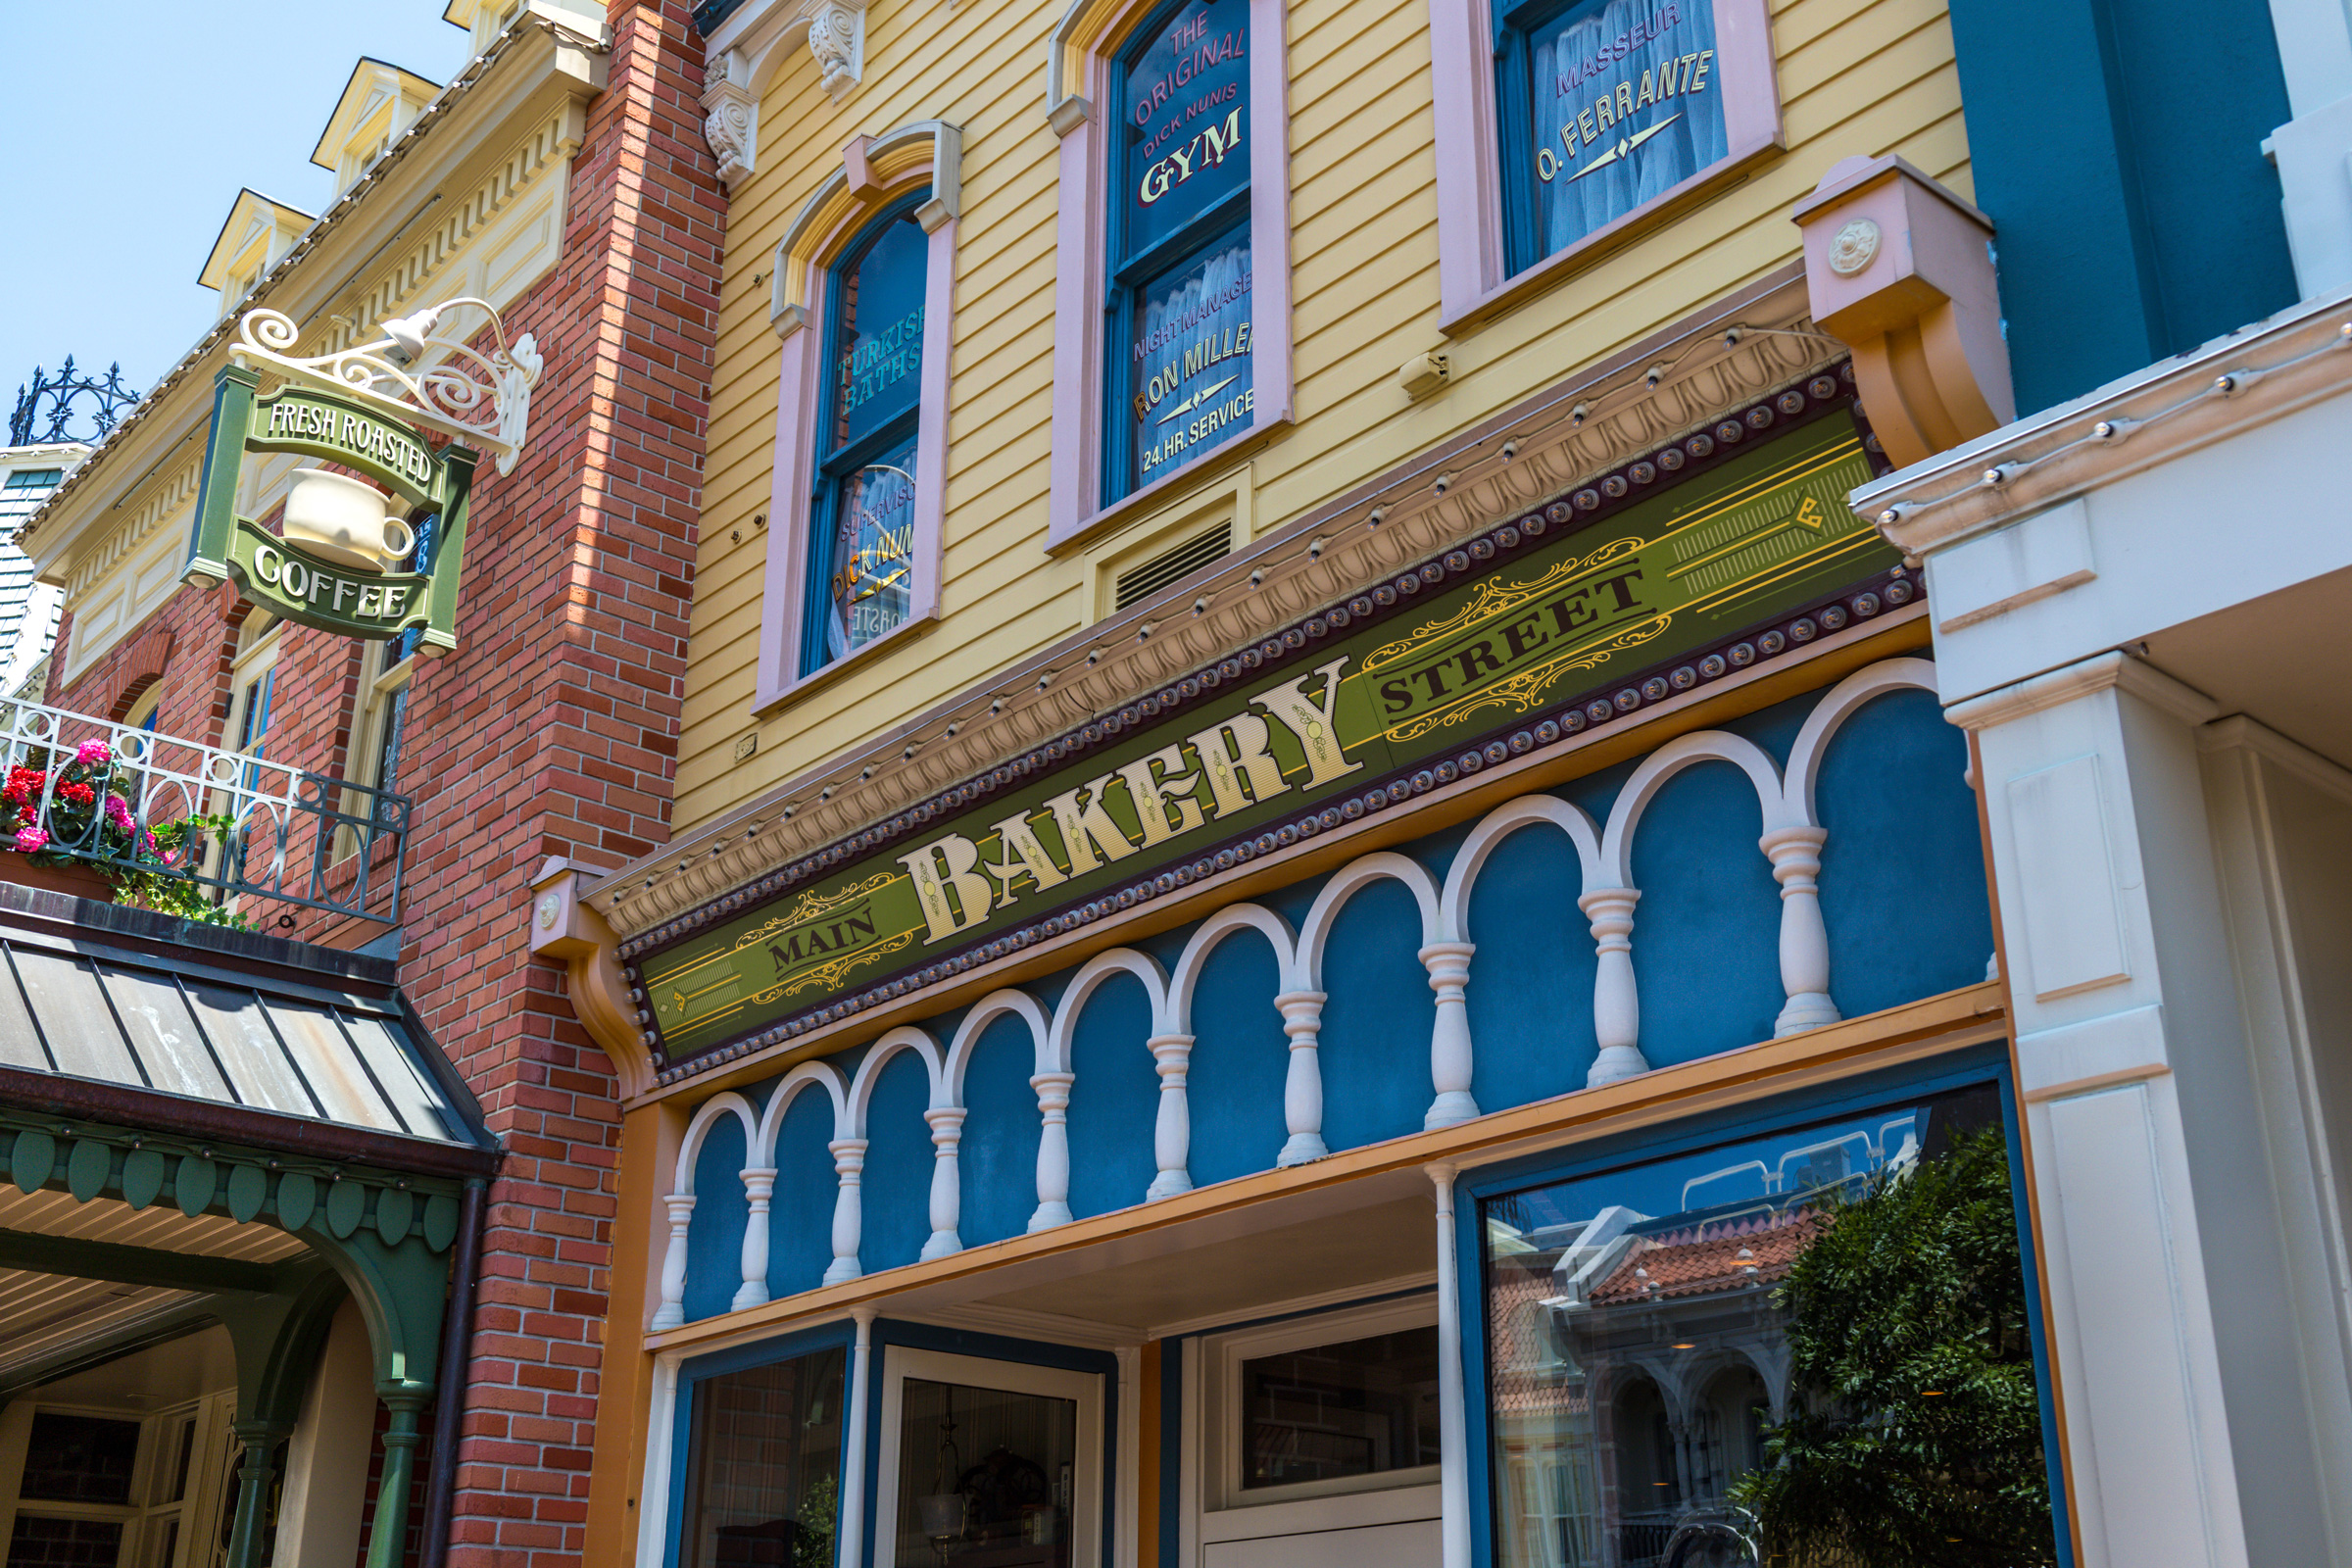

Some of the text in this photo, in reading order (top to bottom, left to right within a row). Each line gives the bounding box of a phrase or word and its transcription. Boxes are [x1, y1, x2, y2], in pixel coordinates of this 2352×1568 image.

[1170, 9, 1208, 56] THE
[1556, 0, 1683, 98] MASSEUR
[1135, 27, 1245, 126] ORIGINAL
[1143, 82, 1238, 160] DICK NUNIS
[1537, 49, 1714, 183] O. FERRANTE
[1138, 105, 1244, 206] GYM
[1133, 316, 1181, 363] NIGHT
[1133, 321, 1253, 423] RON MILLE
[843, 342, 921, 416] BATHS
[1189, 388, 1254, 444] SERVICE
[269, 403, 431, 482] FRESH ROASTED
[254, 545, 407, 618] COFFEE
[832, 543, 872, 604] DICK
[768, 569, 1645, 973] MAIN BAKERY STREET
